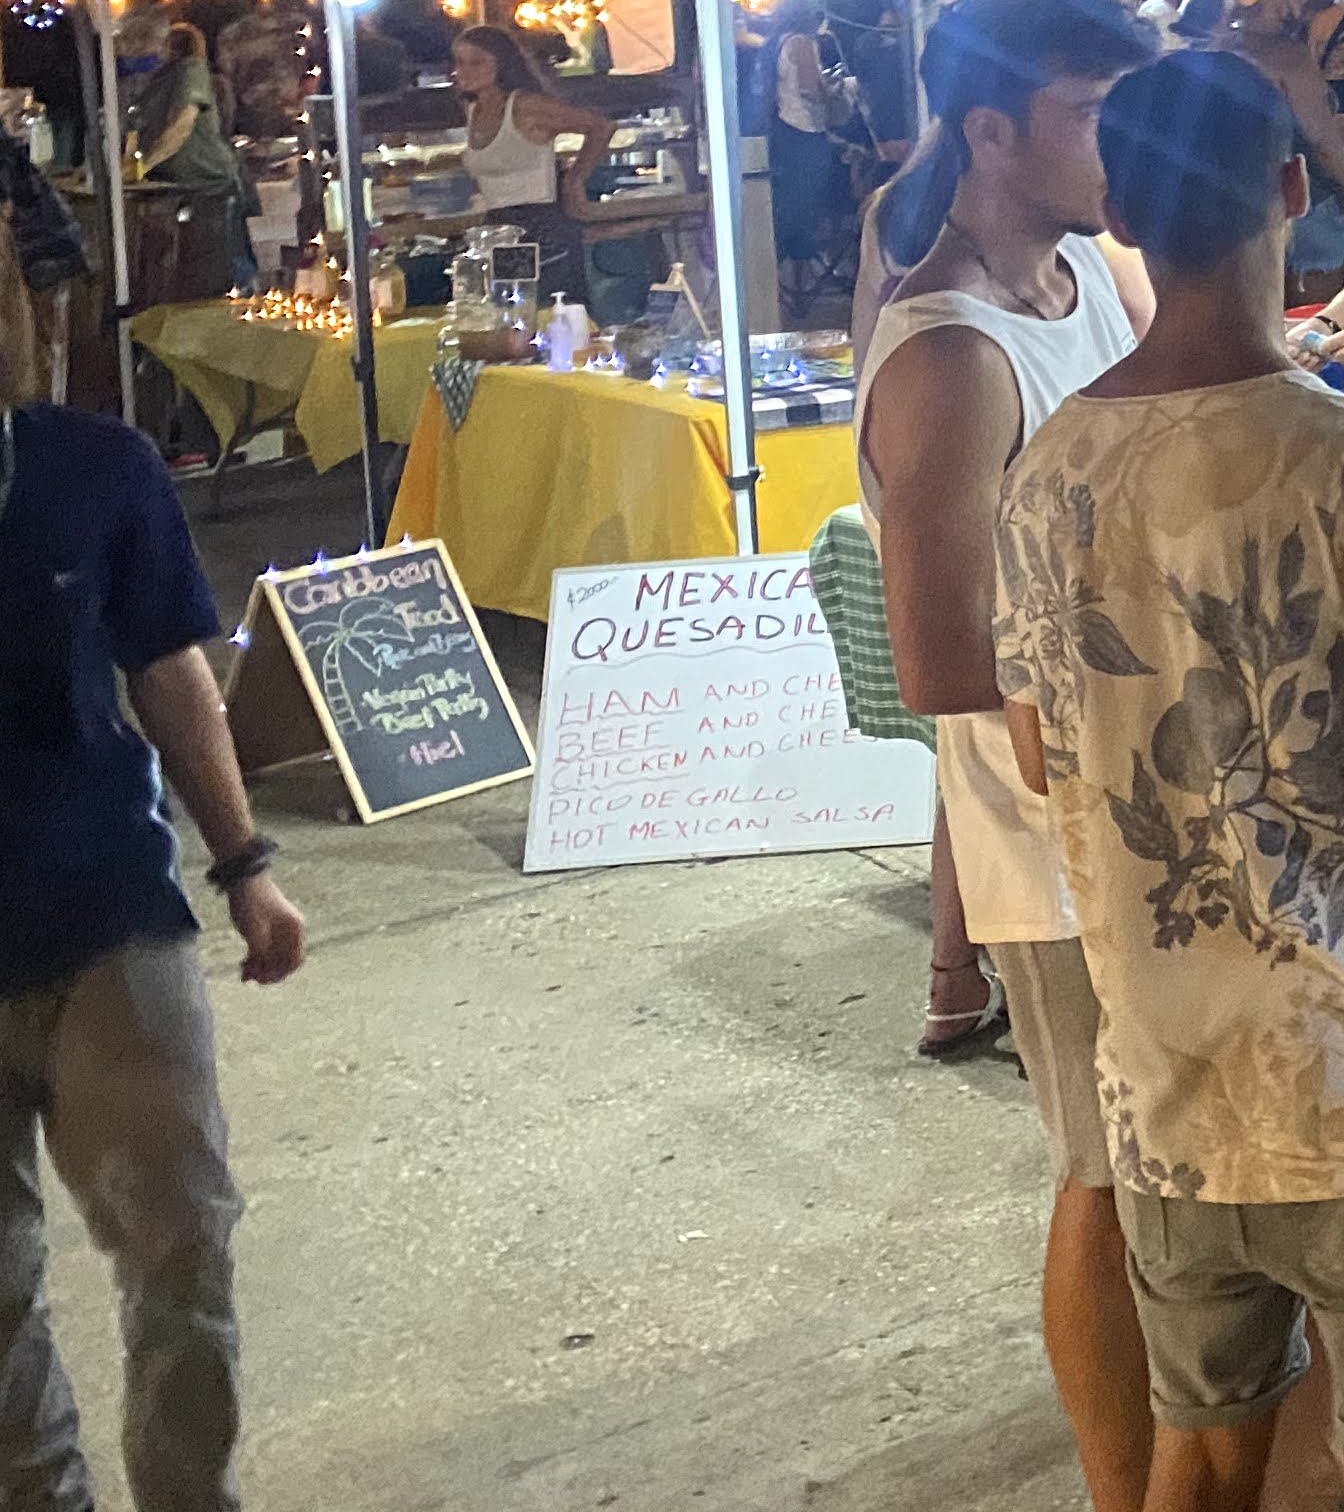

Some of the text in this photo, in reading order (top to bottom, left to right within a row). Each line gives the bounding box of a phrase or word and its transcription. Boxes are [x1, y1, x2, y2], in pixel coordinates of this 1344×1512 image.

[570, 612, 832, 663] QUESADIL
[560, 686, 680, 722] HAM
[703, 678, 770, 701] AND
[557, 698, 847, 763] BEEF AND CHE
[551, 750, 688, 791] CHICKEN
[700, 740, 766, 762] AND
[548, 785, 799, 825] PICO DE GALLO
[550, 803, 896, 854] HOT MEXICAN SALSA
